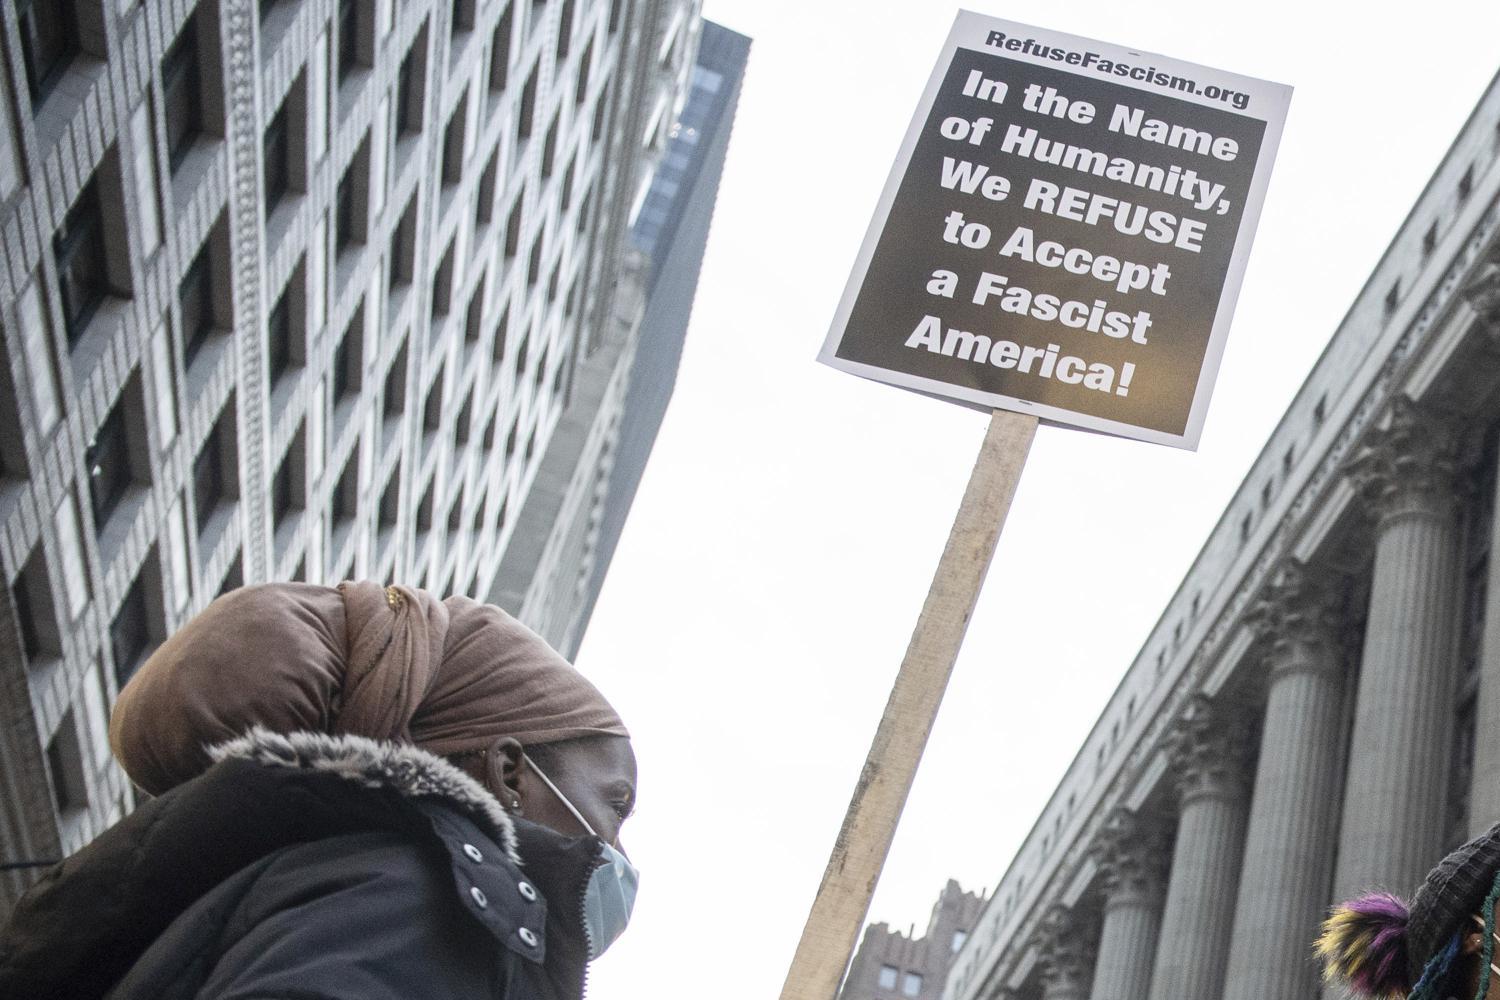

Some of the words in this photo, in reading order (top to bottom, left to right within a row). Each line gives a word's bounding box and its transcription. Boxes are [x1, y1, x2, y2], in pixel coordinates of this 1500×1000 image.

[985, 30, 1251, 110] RefuseFascism.org
[961, 69, 1009, 105] In
[1022, 83, 1097, 125] the
[1107, 103, 1240, 162] Name
[939, 116, 993, 146] of
[1000, 124, 1231, 216] Humanity,
[939, 156, 1011, 202] We
[1023, 178, 1208, 253] REFUSE
[942, 210, 992, 250] to
[999, 226, 1172, 296] Accept
[926, 269, 959, 299] a
[972, 271, 1153, 346] Fascist
[904, 314, 1137, 398] America!
